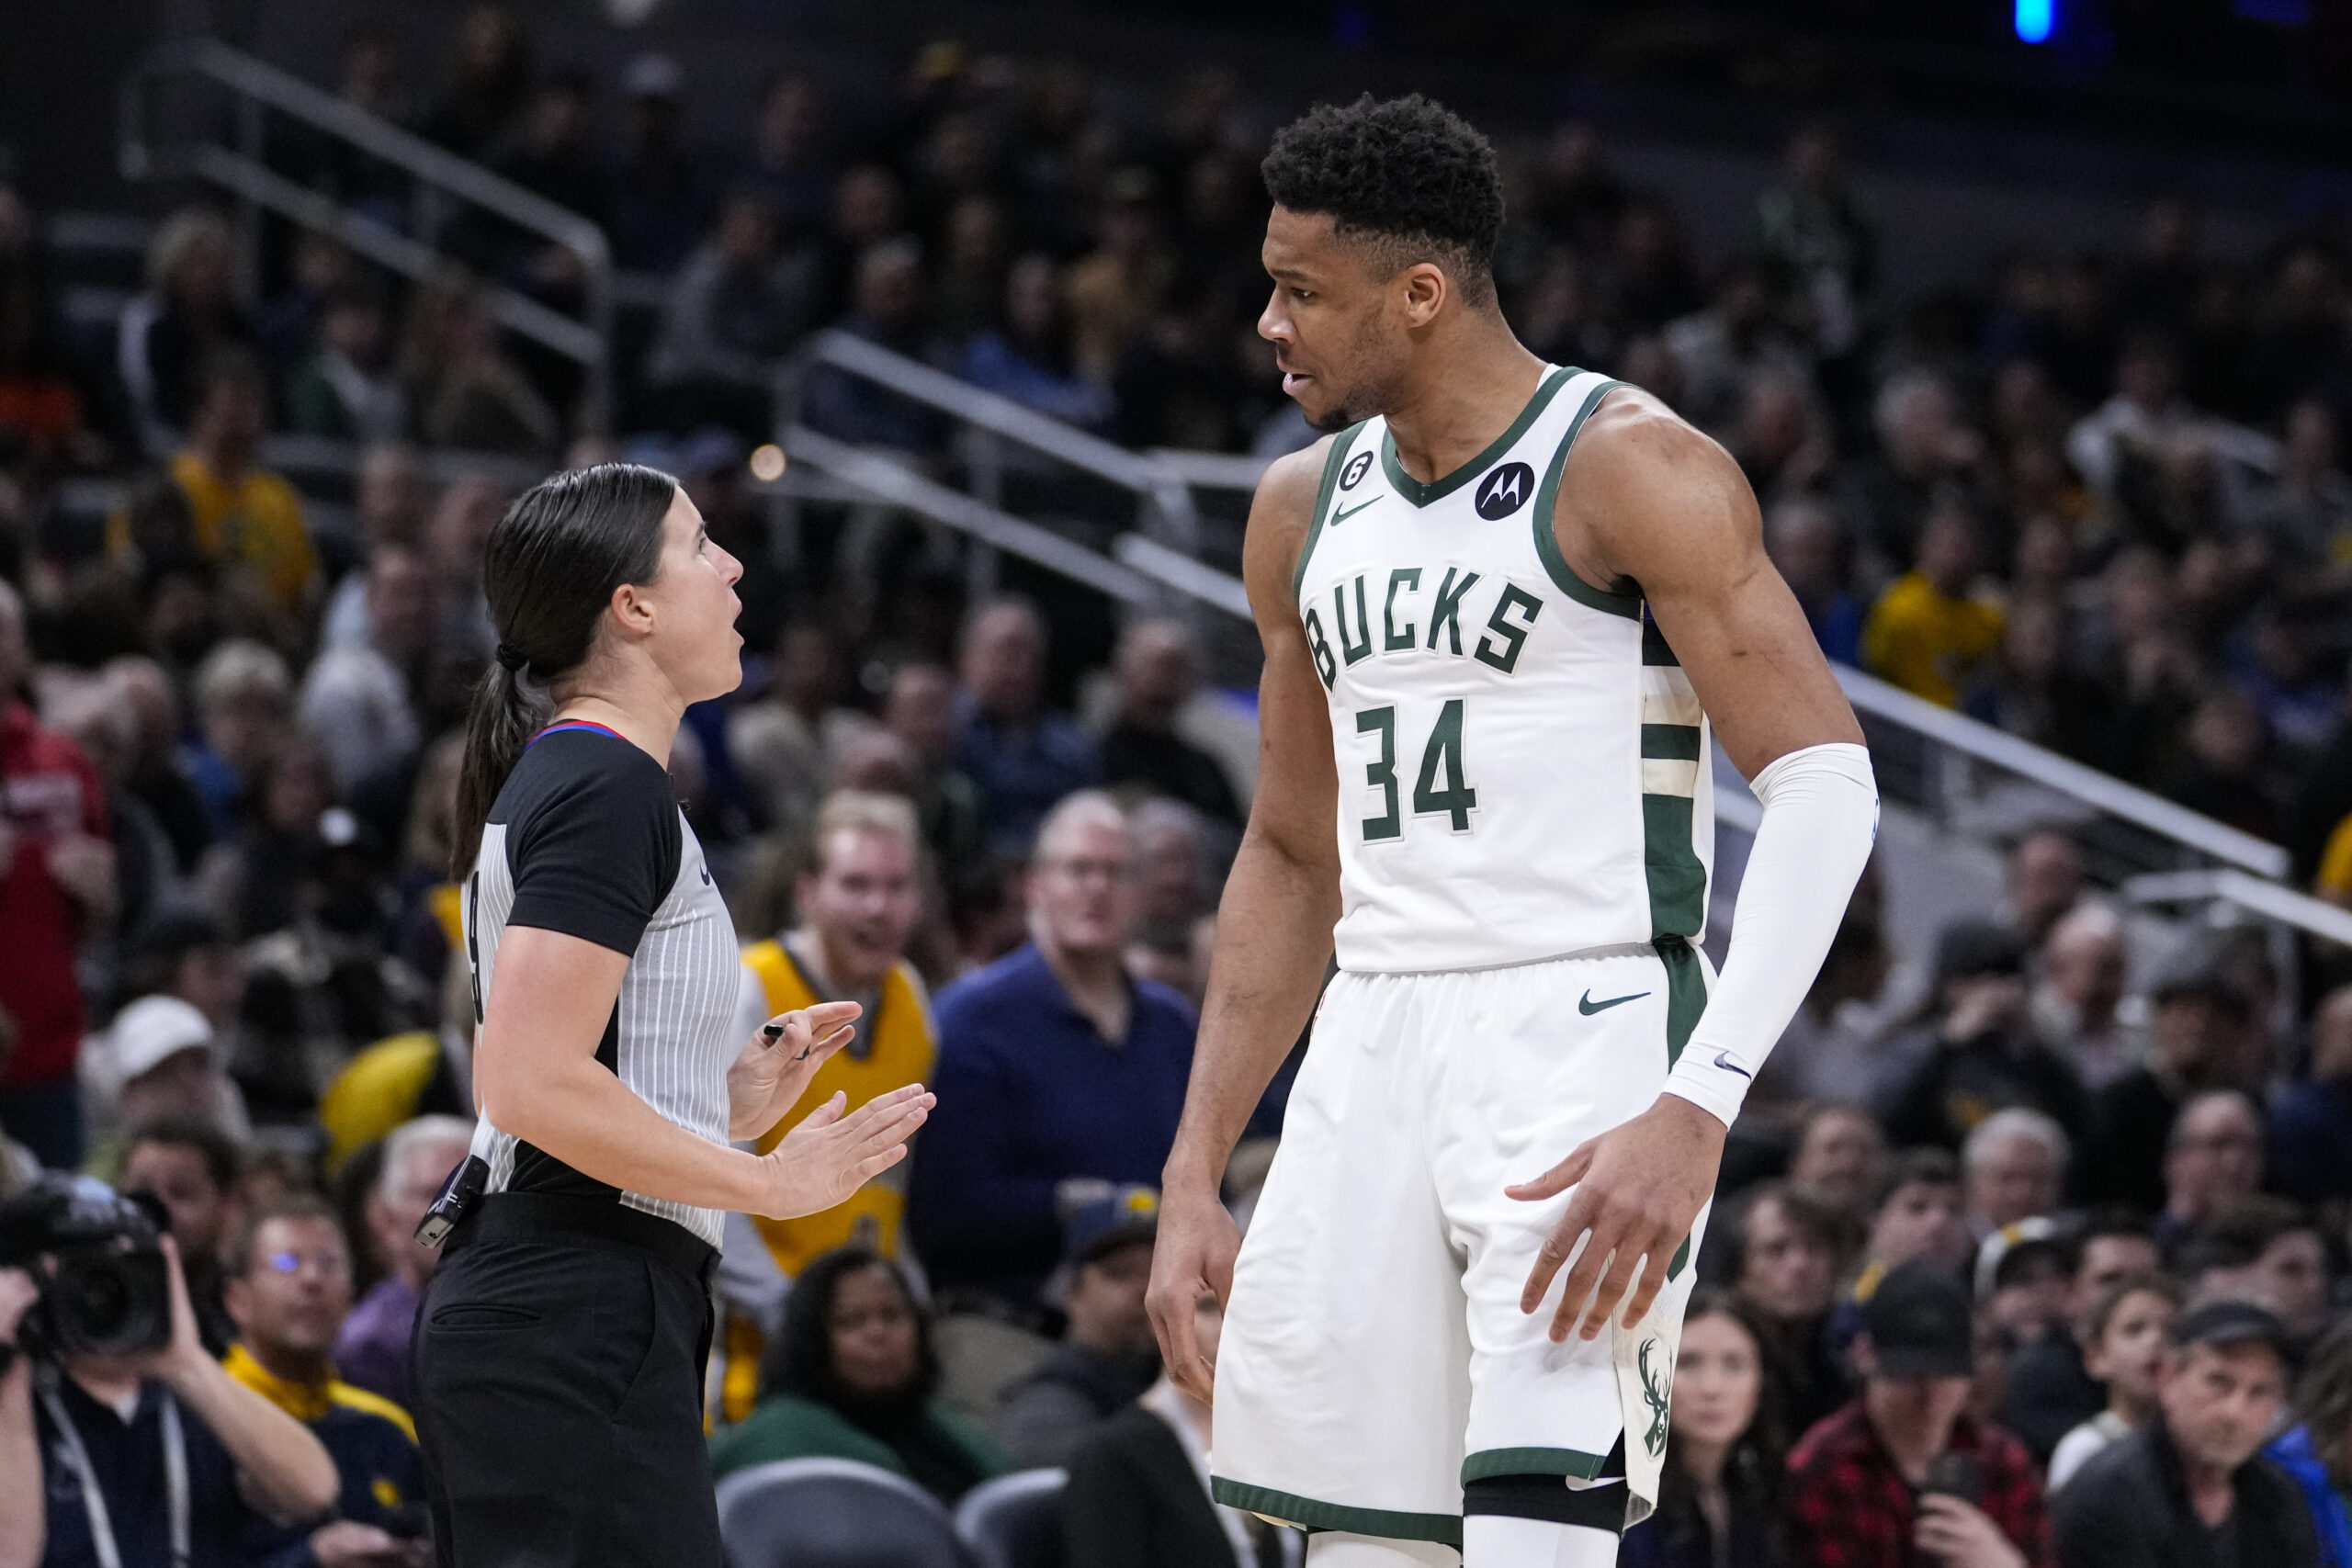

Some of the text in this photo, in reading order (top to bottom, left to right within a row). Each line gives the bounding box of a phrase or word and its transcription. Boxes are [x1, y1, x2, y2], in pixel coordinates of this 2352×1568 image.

[1344, 456, 1368, 487] 6
[1305, 567, 1544, 694] BUCKS
[1355, 699, 1476, 841] 34
